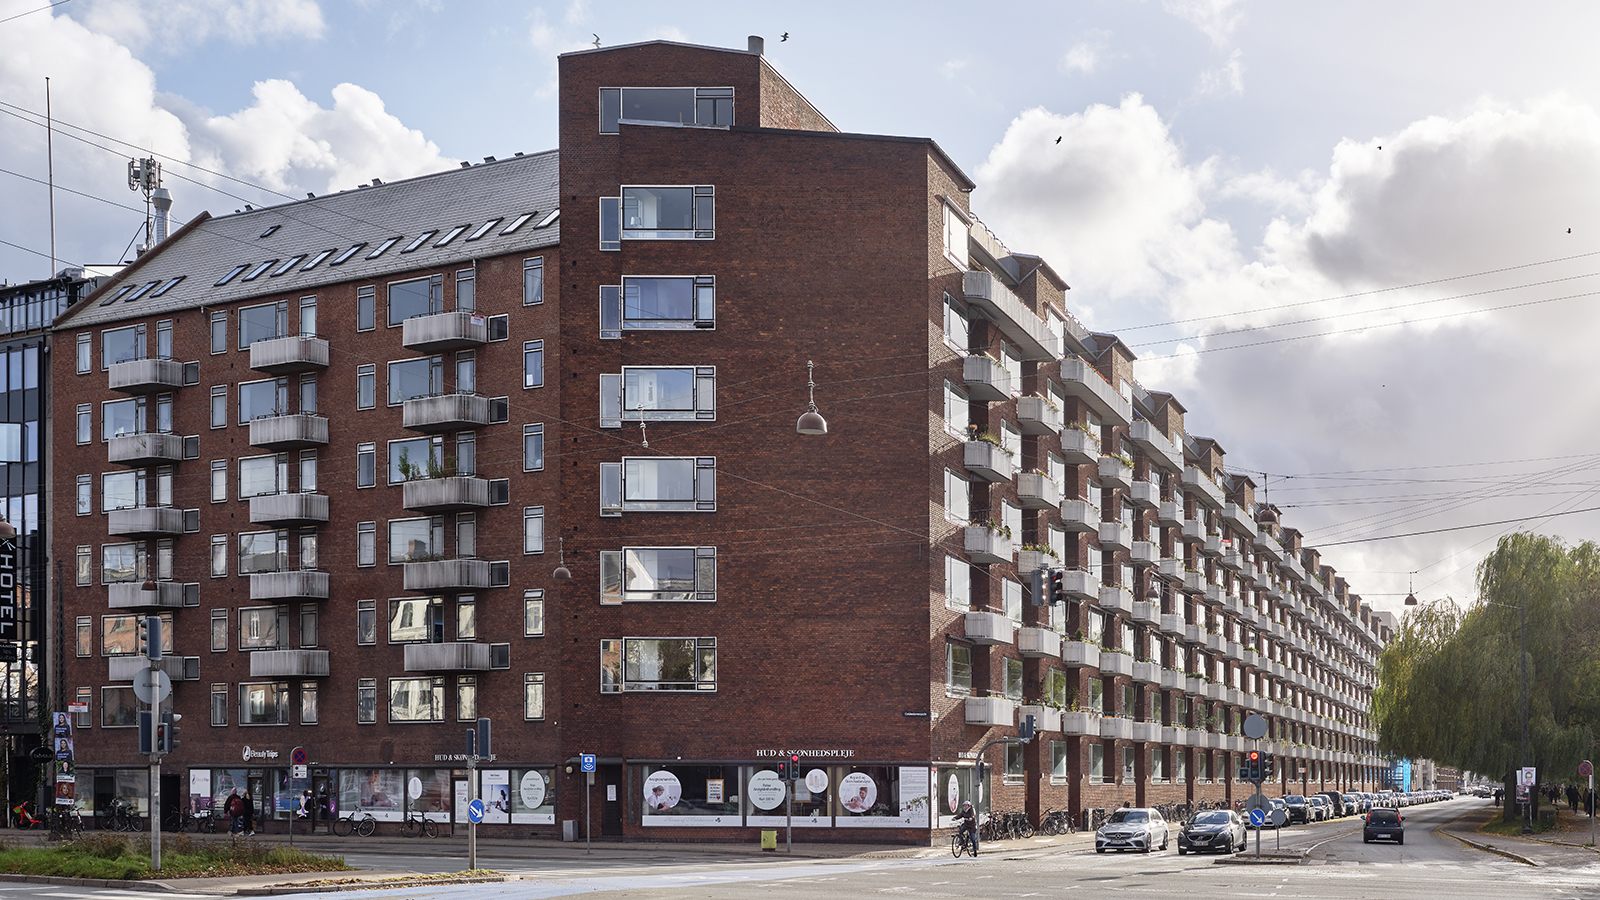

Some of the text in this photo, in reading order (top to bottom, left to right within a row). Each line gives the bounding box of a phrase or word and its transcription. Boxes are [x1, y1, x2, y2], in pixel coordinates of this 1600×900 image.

[0, 553, 14, 634] HOTEL
[250, 750, 279, 759] Beauty Trips
[756, 749, 777, 757] HUD
[778, 749, 785, 757] &
